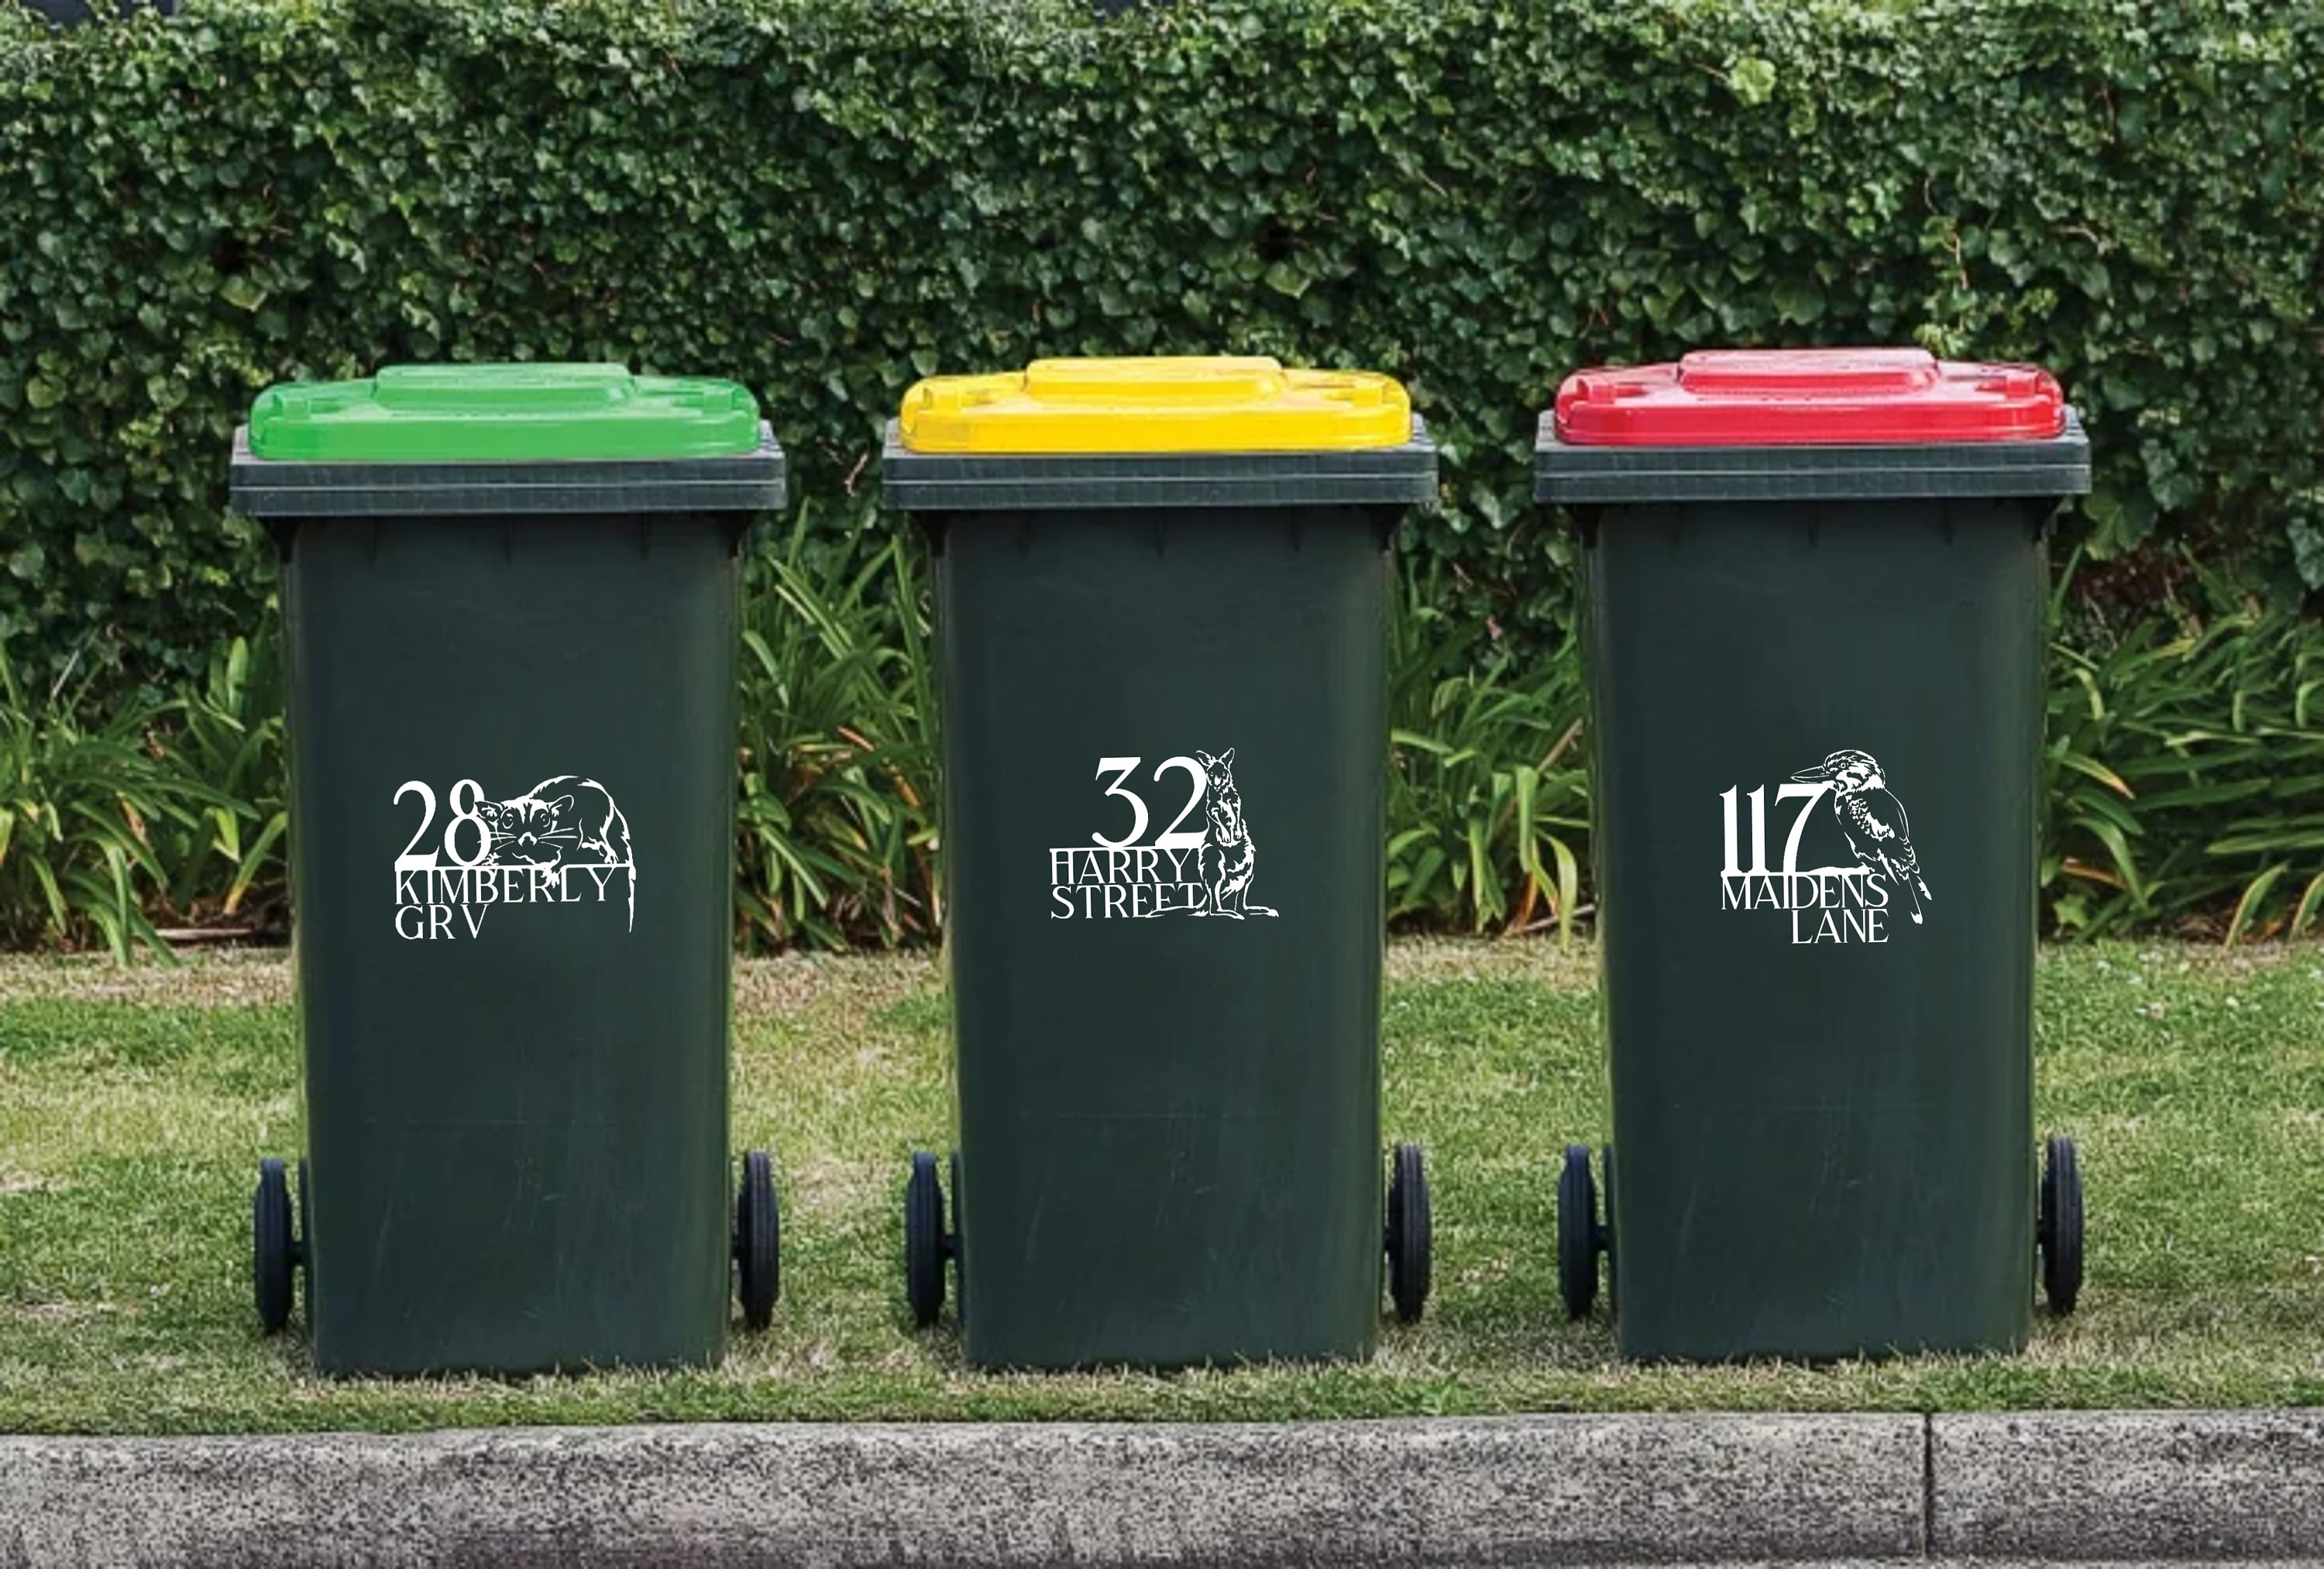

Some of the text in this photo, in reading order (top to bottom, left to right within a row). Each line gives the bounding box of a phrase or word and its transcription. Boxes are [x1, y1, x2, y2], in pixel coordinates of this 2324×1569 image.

[1092, 756, 1208, 848] 32
[393, 779, 492, 869] 28
[1719, 783, 1830, 874] 117
[395, 865, 617, 905] KIMBERLY
[1050, 848, 1195, 885] HARRY
[1050, 883, 1205, 920] STREET
[1721, 872, 1889, 910] MAIDENS
[395, 903, 490, 940] GRV
[1791, 908, 1889, 944] LANE
